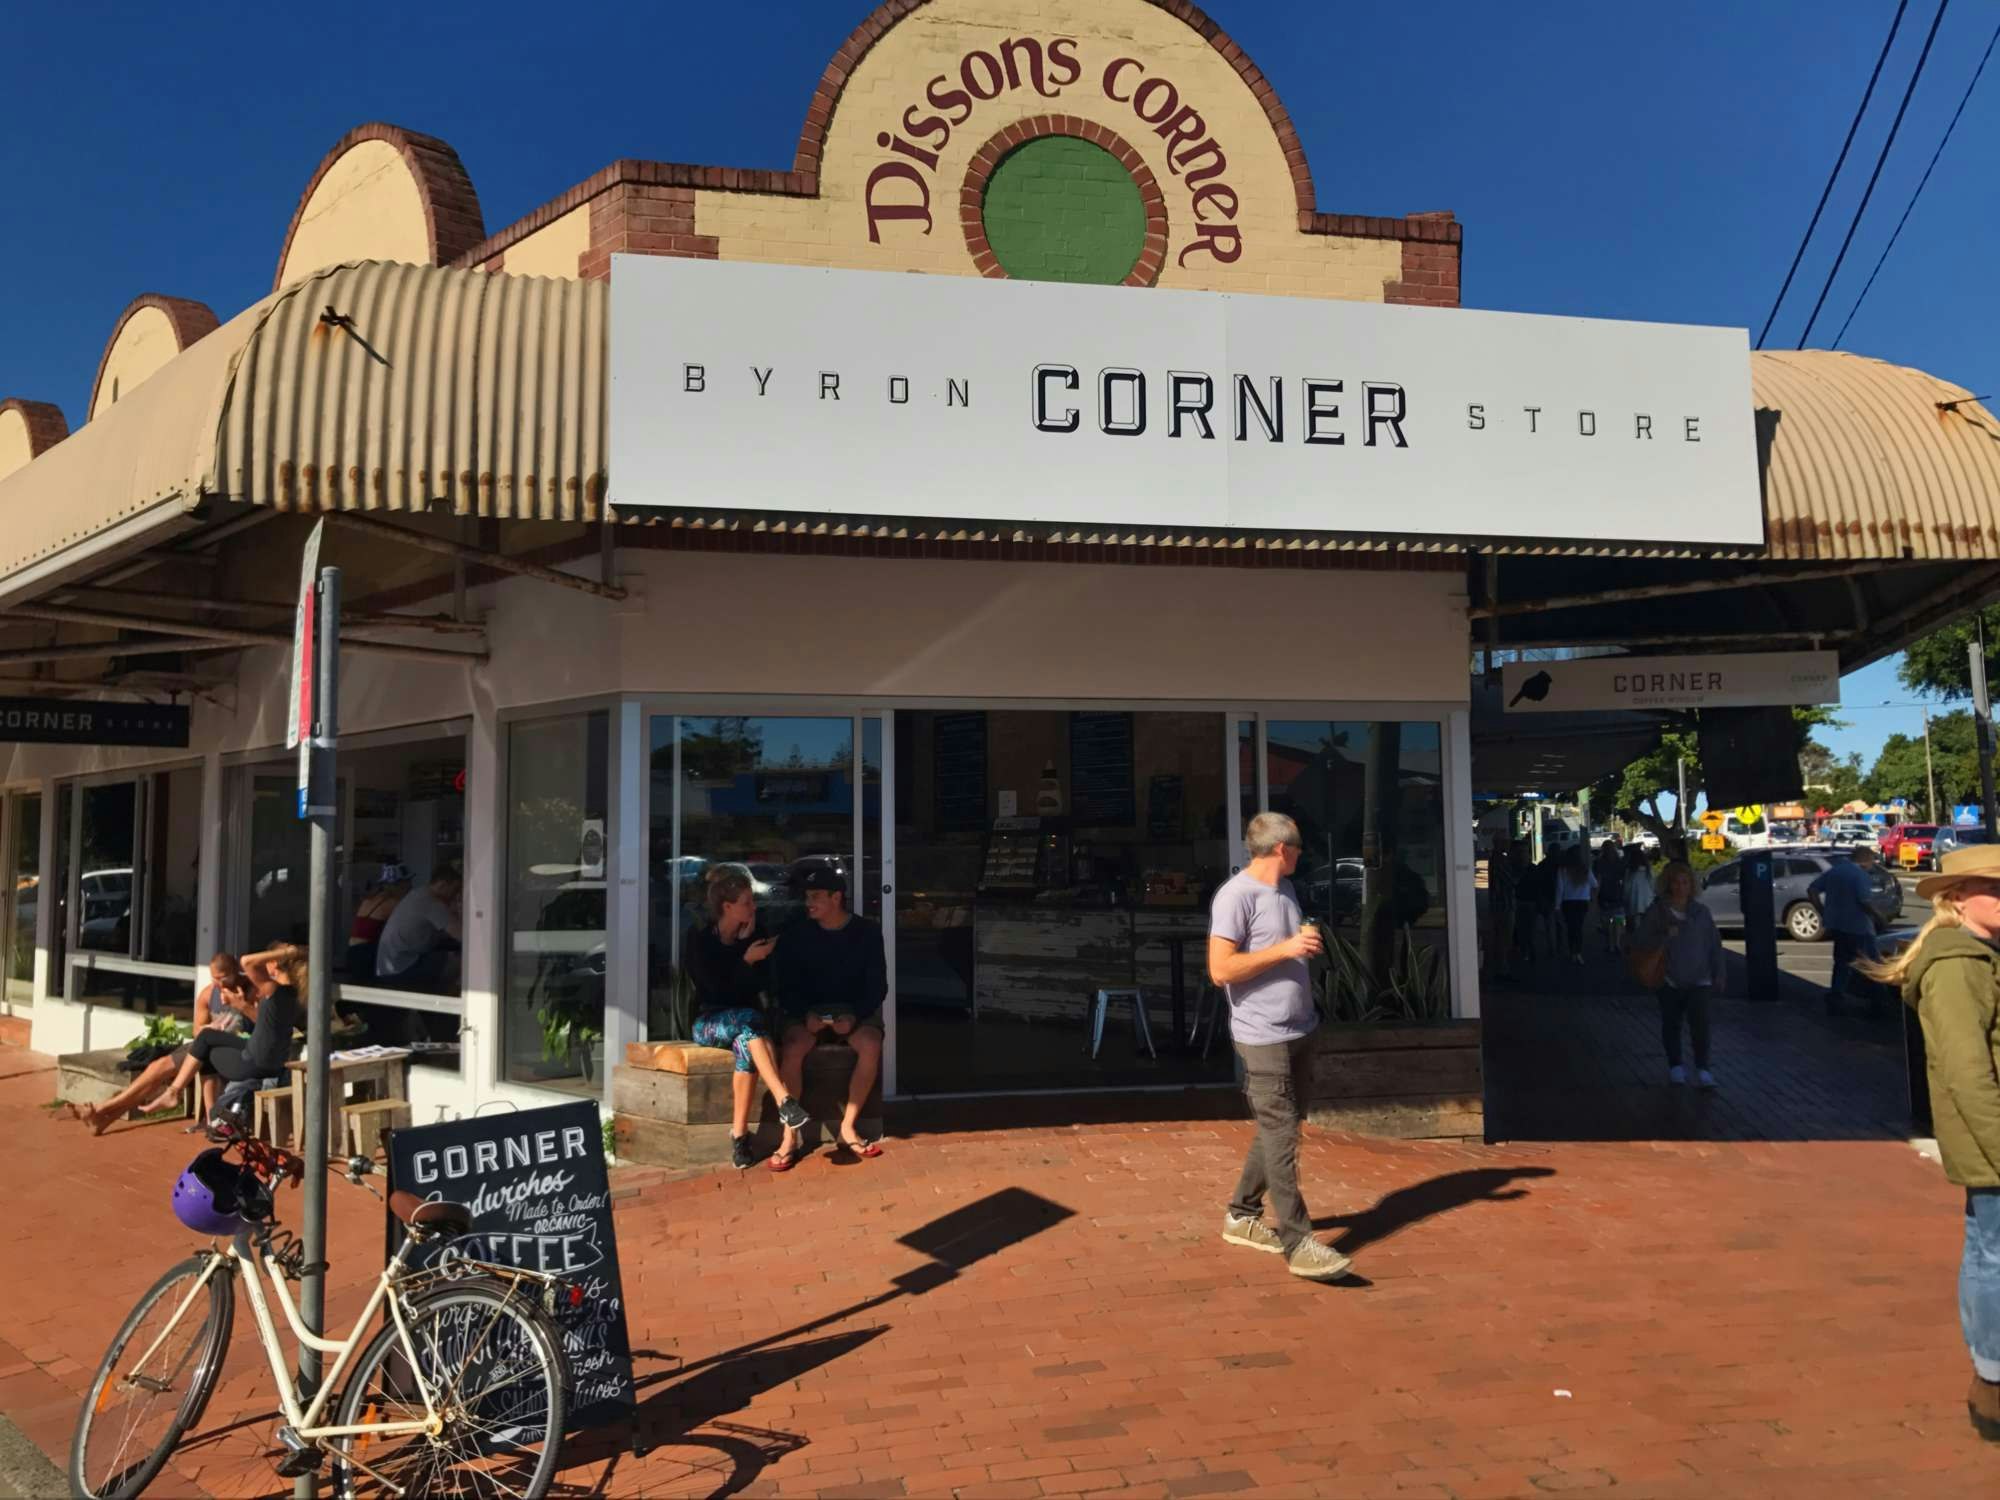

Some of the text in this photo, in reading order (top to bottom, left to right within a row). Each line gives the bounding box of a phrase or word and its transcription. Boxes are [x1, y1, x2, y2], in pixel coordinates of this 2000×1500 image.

[865, 37, 1081, 245] Dissons
[682, 362, 1701, 449] BYRON CORNER STORE
[1613, 671, 1724, 694] CORNER
[1756, 863, 1768, 878] P
[413, 1125, 588, 1185] CORNER
[424, 1168, 576, 1220] dwiches
[505, 1198, 549, 1223] Made
[552, 1195, 567, 1216] to
